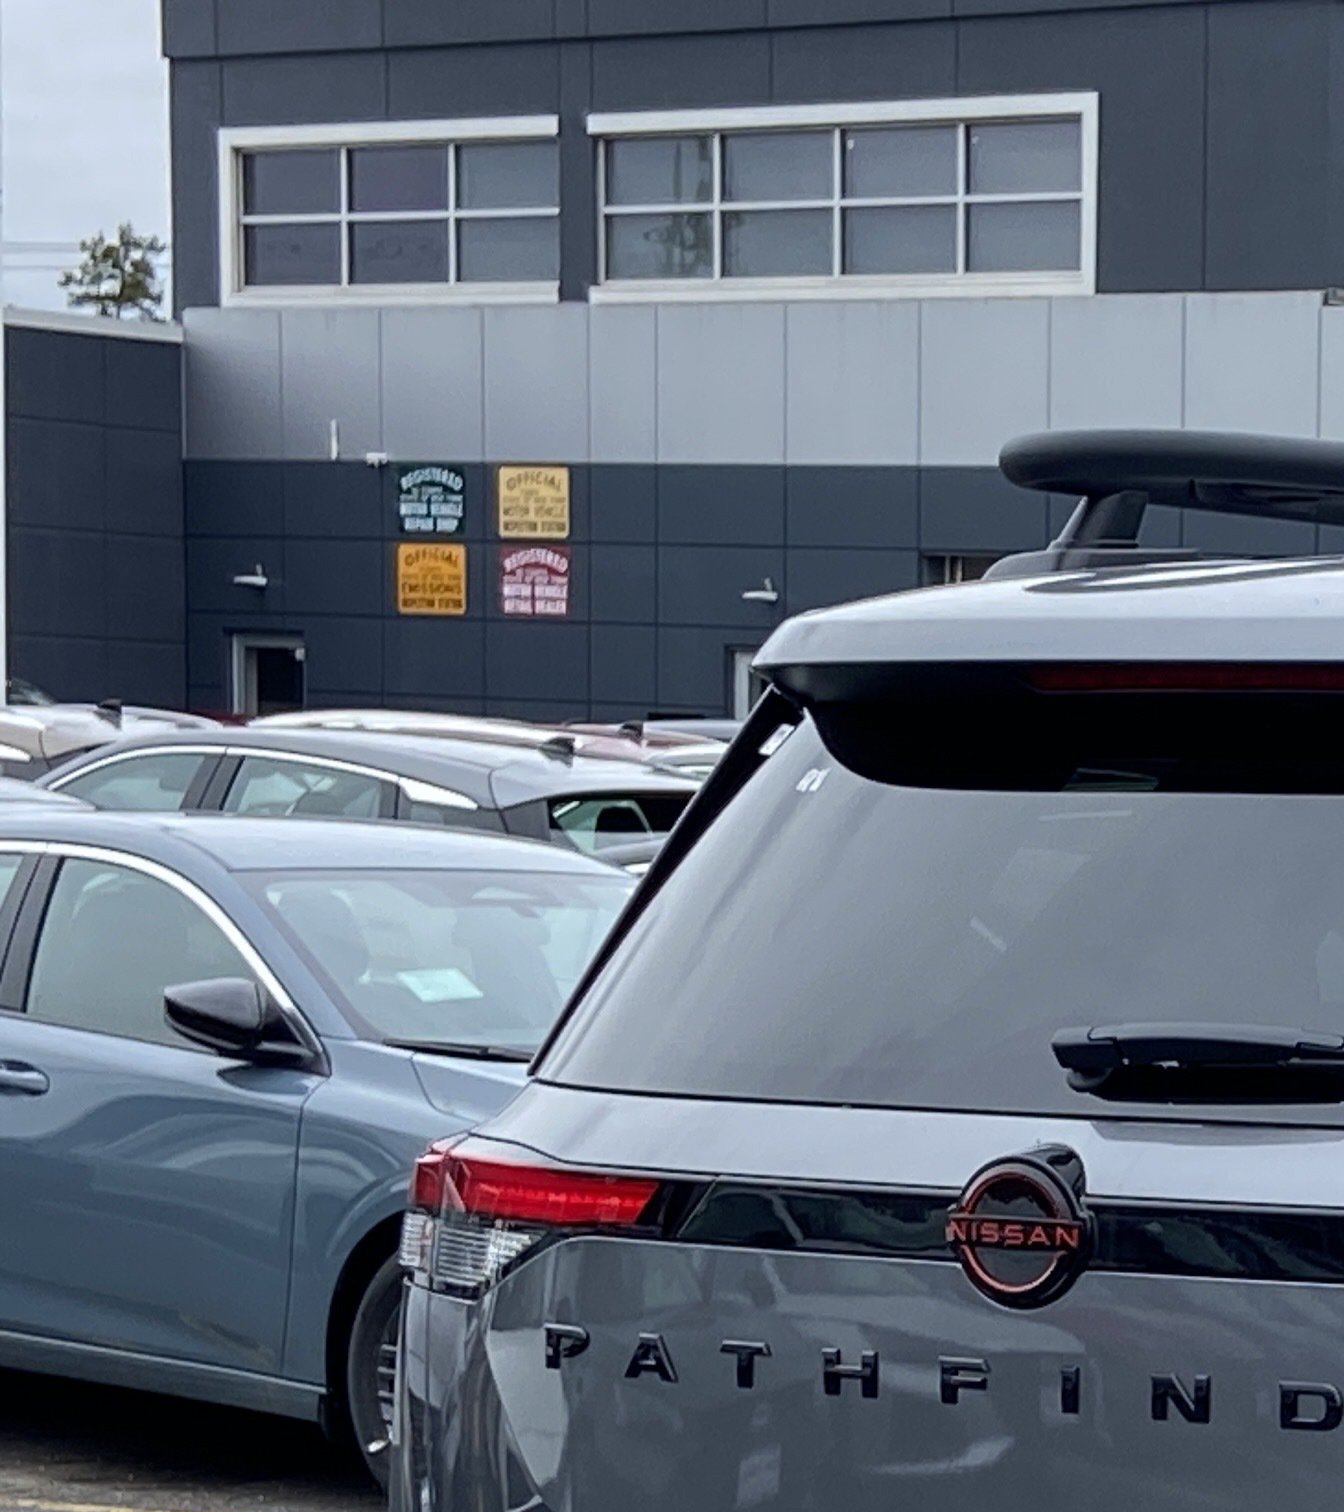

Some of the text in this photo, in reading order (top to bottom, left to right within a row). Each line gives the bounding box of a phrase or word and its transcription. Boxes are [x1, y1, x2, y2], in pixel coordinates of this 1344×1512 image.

[506, 471, 562, 493] OFFICIAL
[405, 547, 460, 568] OFFICIAL
[945, 1220, 1080, 1249] NISSAN
